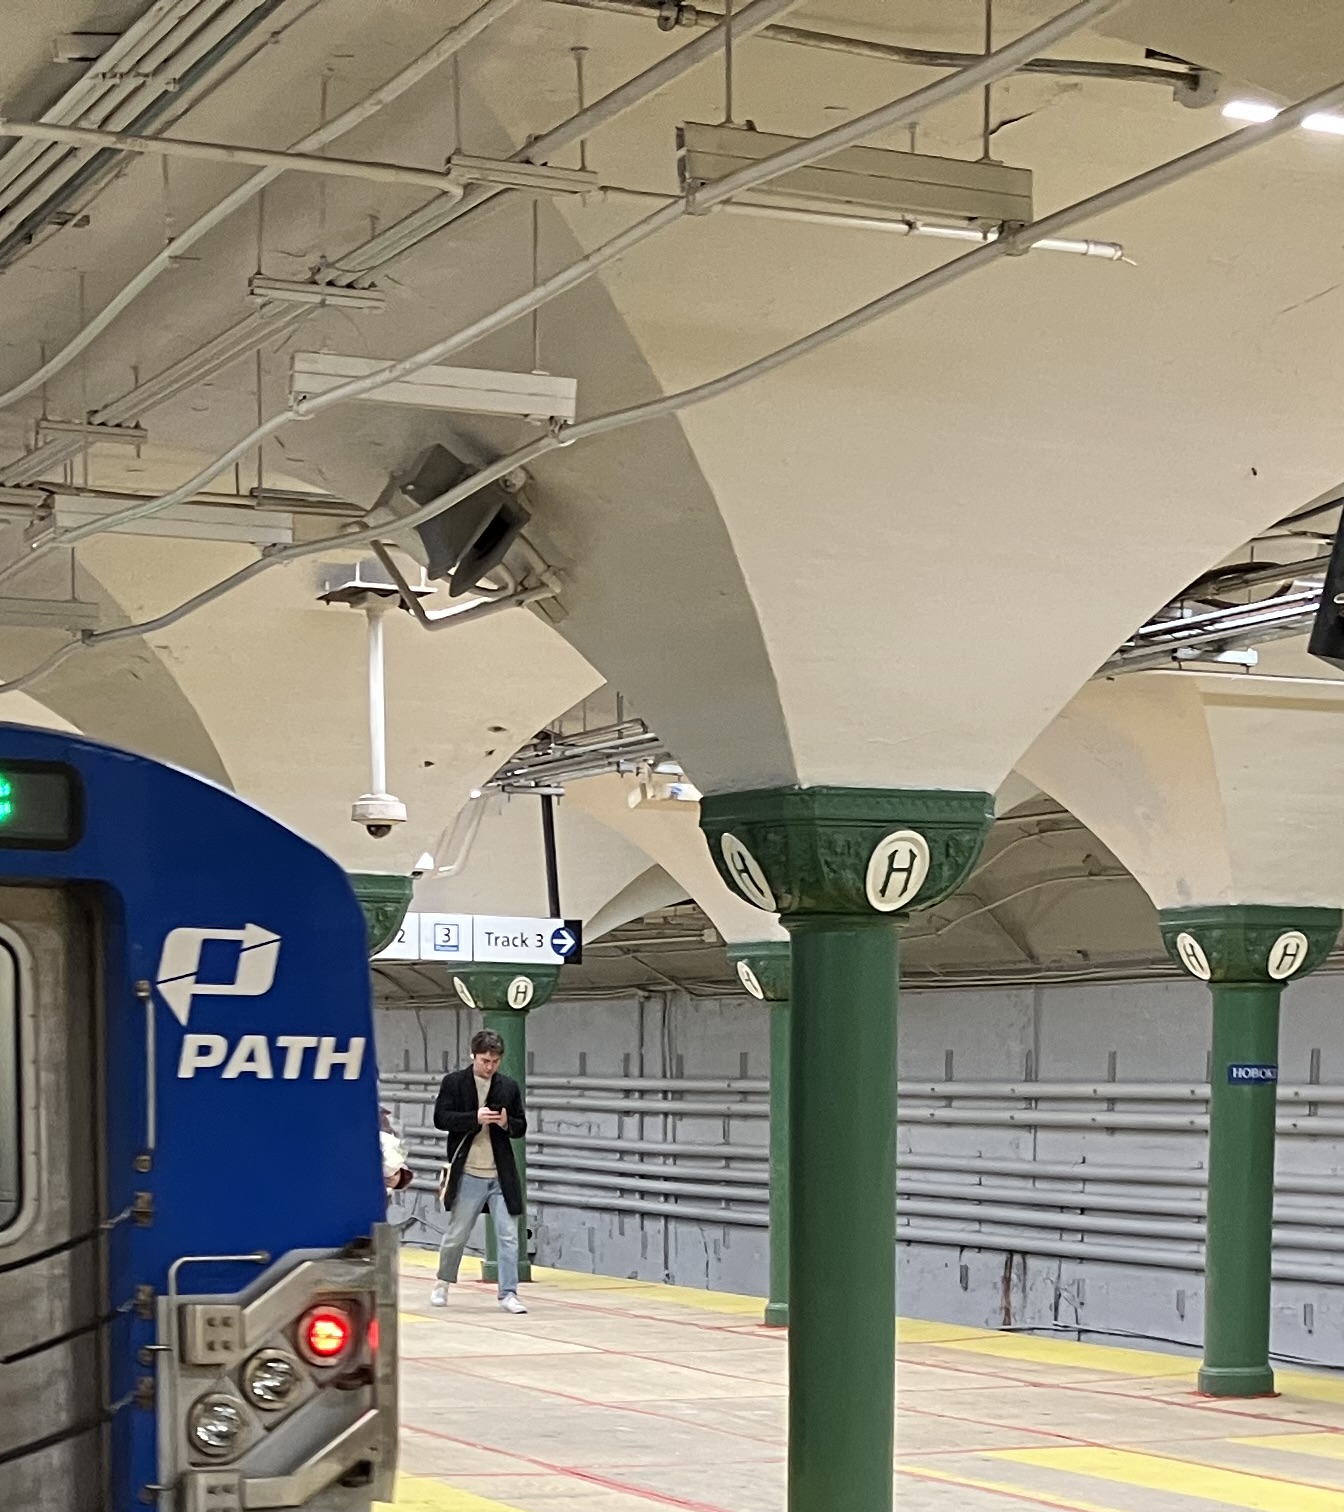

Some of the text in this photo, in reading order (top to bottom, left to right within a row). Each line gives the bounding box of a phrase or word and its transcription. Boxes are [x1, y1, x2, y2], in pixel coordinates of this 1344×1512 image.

[729, 850, 767, 898] H
[878, 847, 918, 898] H
[441, 927, 451, 944] 3
[484, 931, 545, 949] Track 3
[1182, 942, 1205, 972] H
[1275, 942, 1300, 971] H
[513, 984, 529, 1003] H
[177, 1033, 366, 1081] PATH
